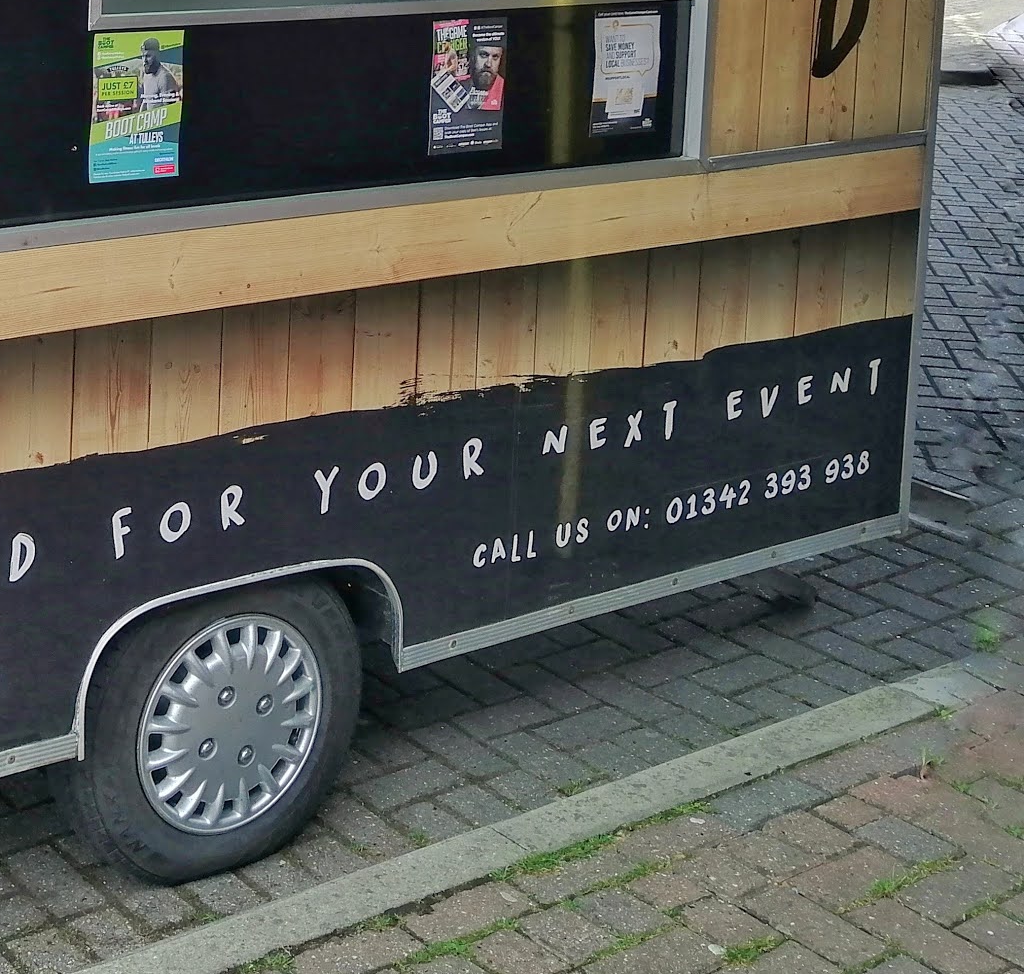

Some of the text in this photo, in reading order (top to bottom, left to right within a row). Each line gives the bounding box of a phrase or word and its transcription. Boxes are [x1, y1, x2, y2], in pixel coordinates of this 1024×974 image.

[450, 25, 467, 39] GAME
[618, 42, 635, 50] MONEY
[616, 50, 636, 58] SUPPORT
[605, 60, 620, 68] LOCAL
[102, 82, 121, 90] JUST
[105, 108, 168, 140] BOOT CAMP
[129, 131, 164, 144] AT TULLEYS
[111, 484, 246, 559] FOR
[313, 437, 485, 515] YOUR
[542, 399, 678, 456] NEXT
[726, 358, 882, 421] EVENT
[472, 450, 871, 569] CALL US ON: 01342 393 938
